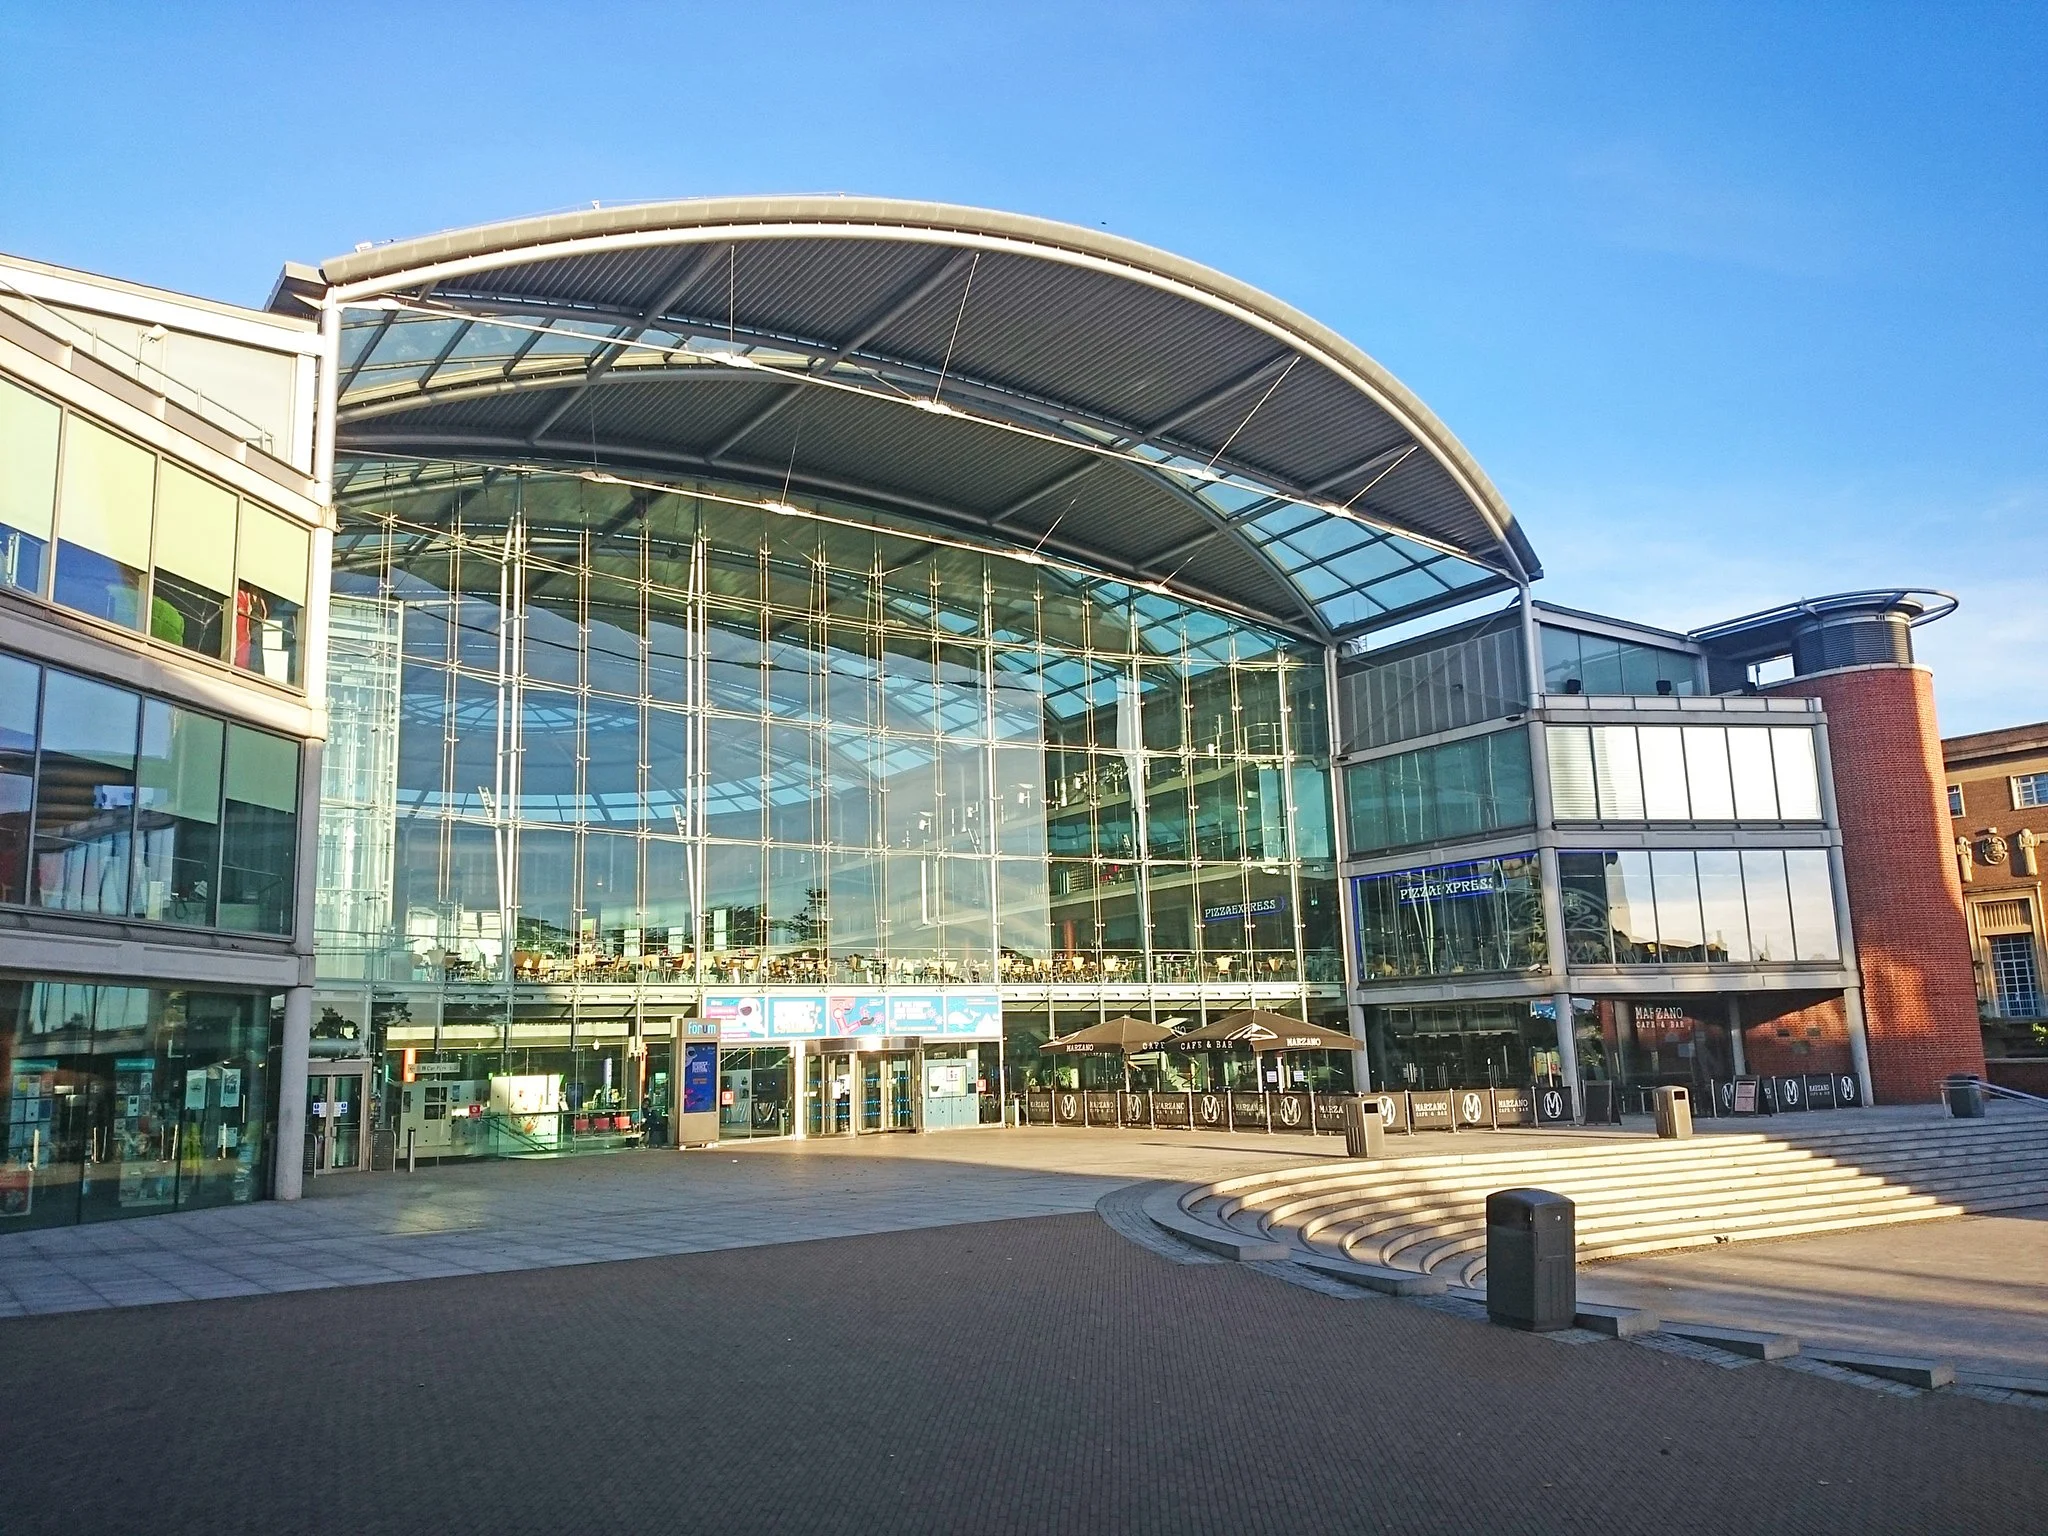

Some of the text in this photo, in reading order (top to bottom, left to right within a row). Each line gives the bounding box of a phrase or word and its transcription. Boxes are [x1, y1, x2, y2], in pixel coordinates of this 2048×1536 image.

[1204, 899, 1276, 918] PIZZAEXRESS
[1635, 1006, 1683, 1020] MARZANO
[687, 1021, 717, 1035] forum
[1216, 1040, 1233, 1049] BAR
[1286, 1037, 1322, 1047] MARZANO
[1066, 1043, 1094, 1052] MARZANO
[1414, 1102, 1448, 1112] MARZANO
[1498, 1099, 1528, 1108] MARZANO
[1319, 1105, 1344, 1114] MARZA
